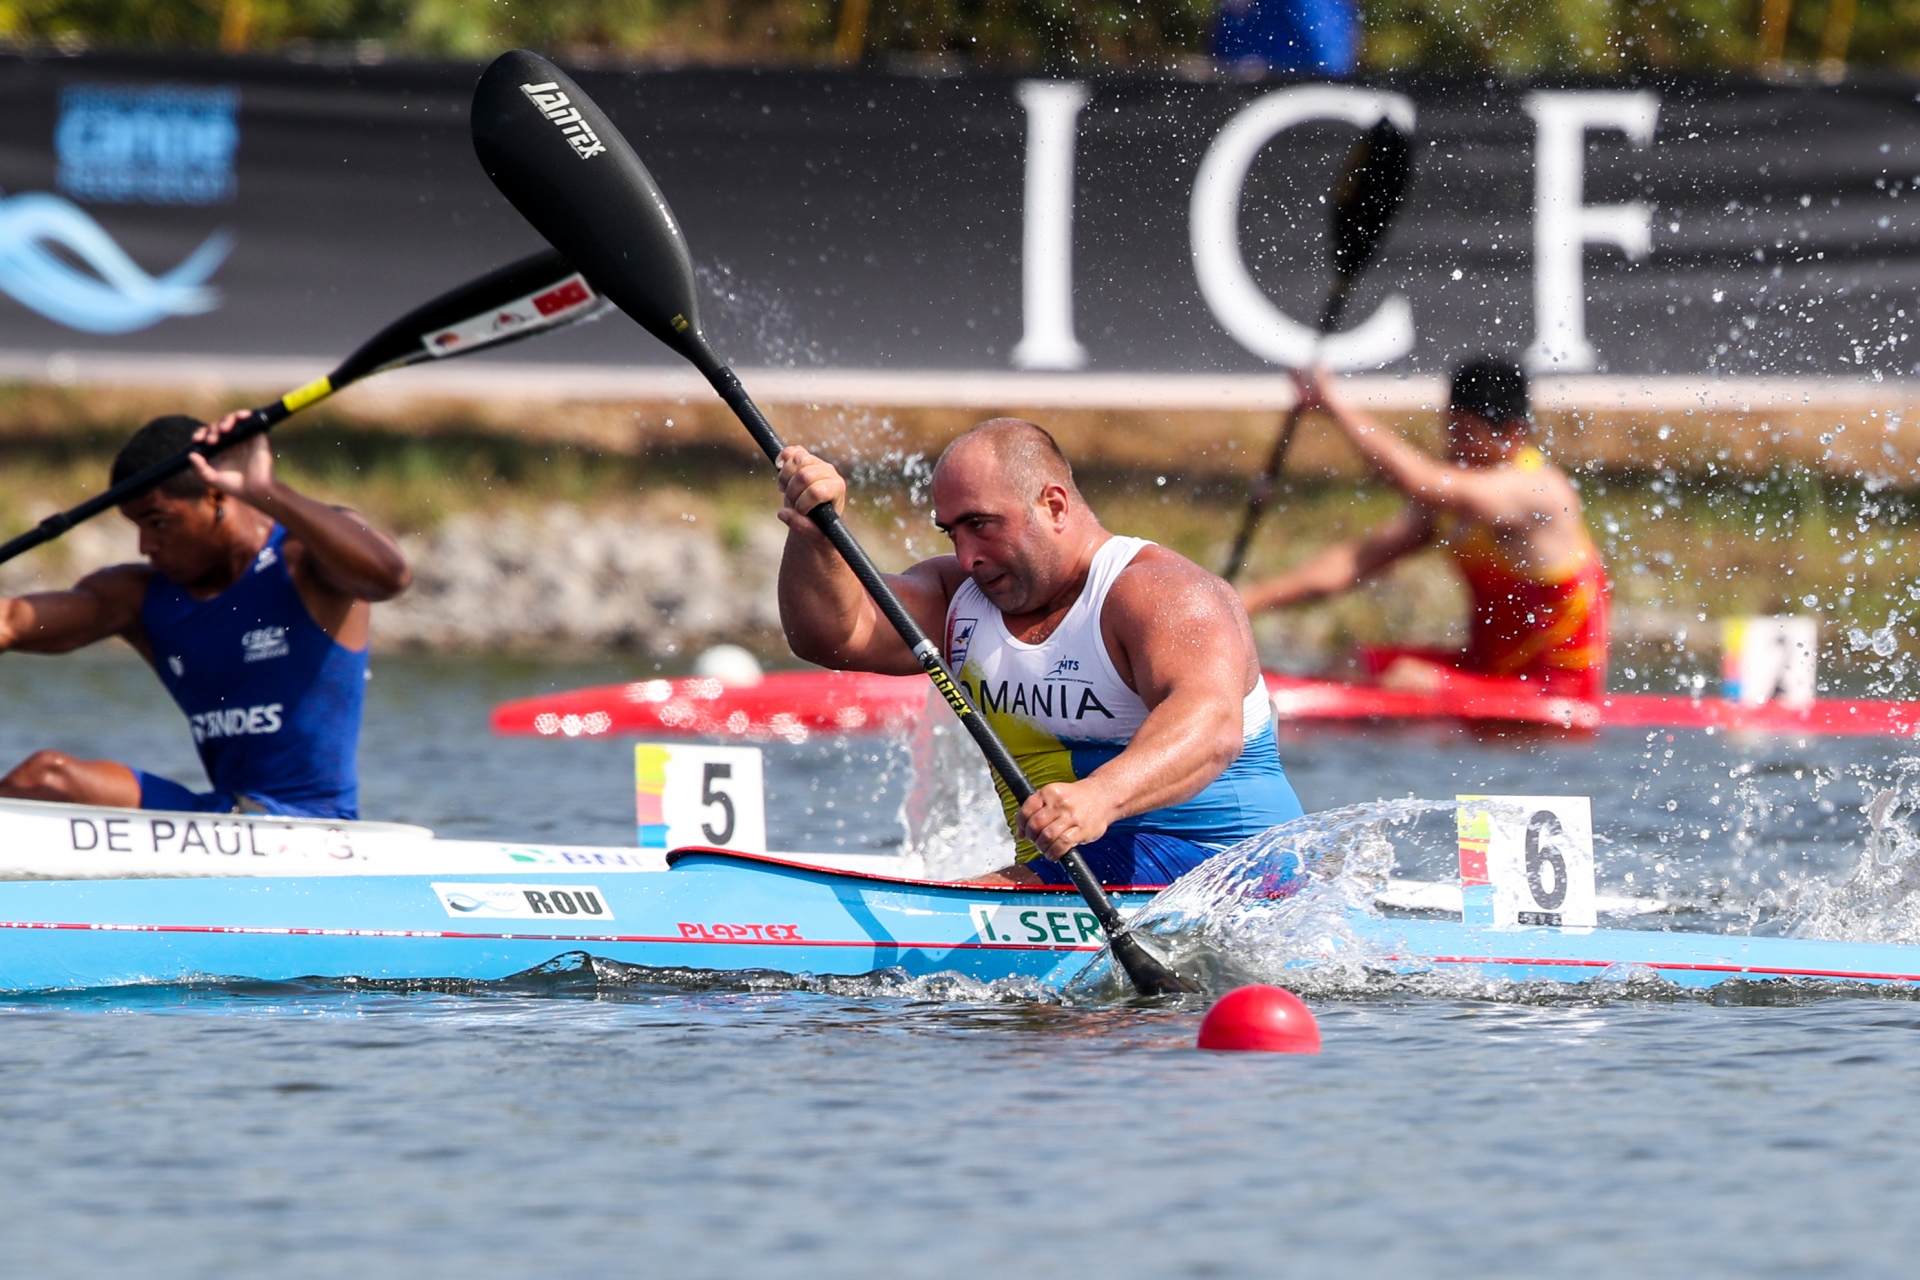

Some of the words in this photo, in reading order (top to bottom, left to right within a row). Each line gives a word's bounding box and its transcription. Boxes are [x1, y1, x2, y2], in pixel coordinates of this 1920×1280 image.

[927, 666, 972, 717] JANTEX
[701, 762, 735, 846] 5
[70, 818, 132, 852] DE
[1525, 810, 1568, 911] 6
[523, 890, 604, 915] ROU
[677, 922, 804, 941] PLASTEX
[979, 910, 1012, 942] I.
